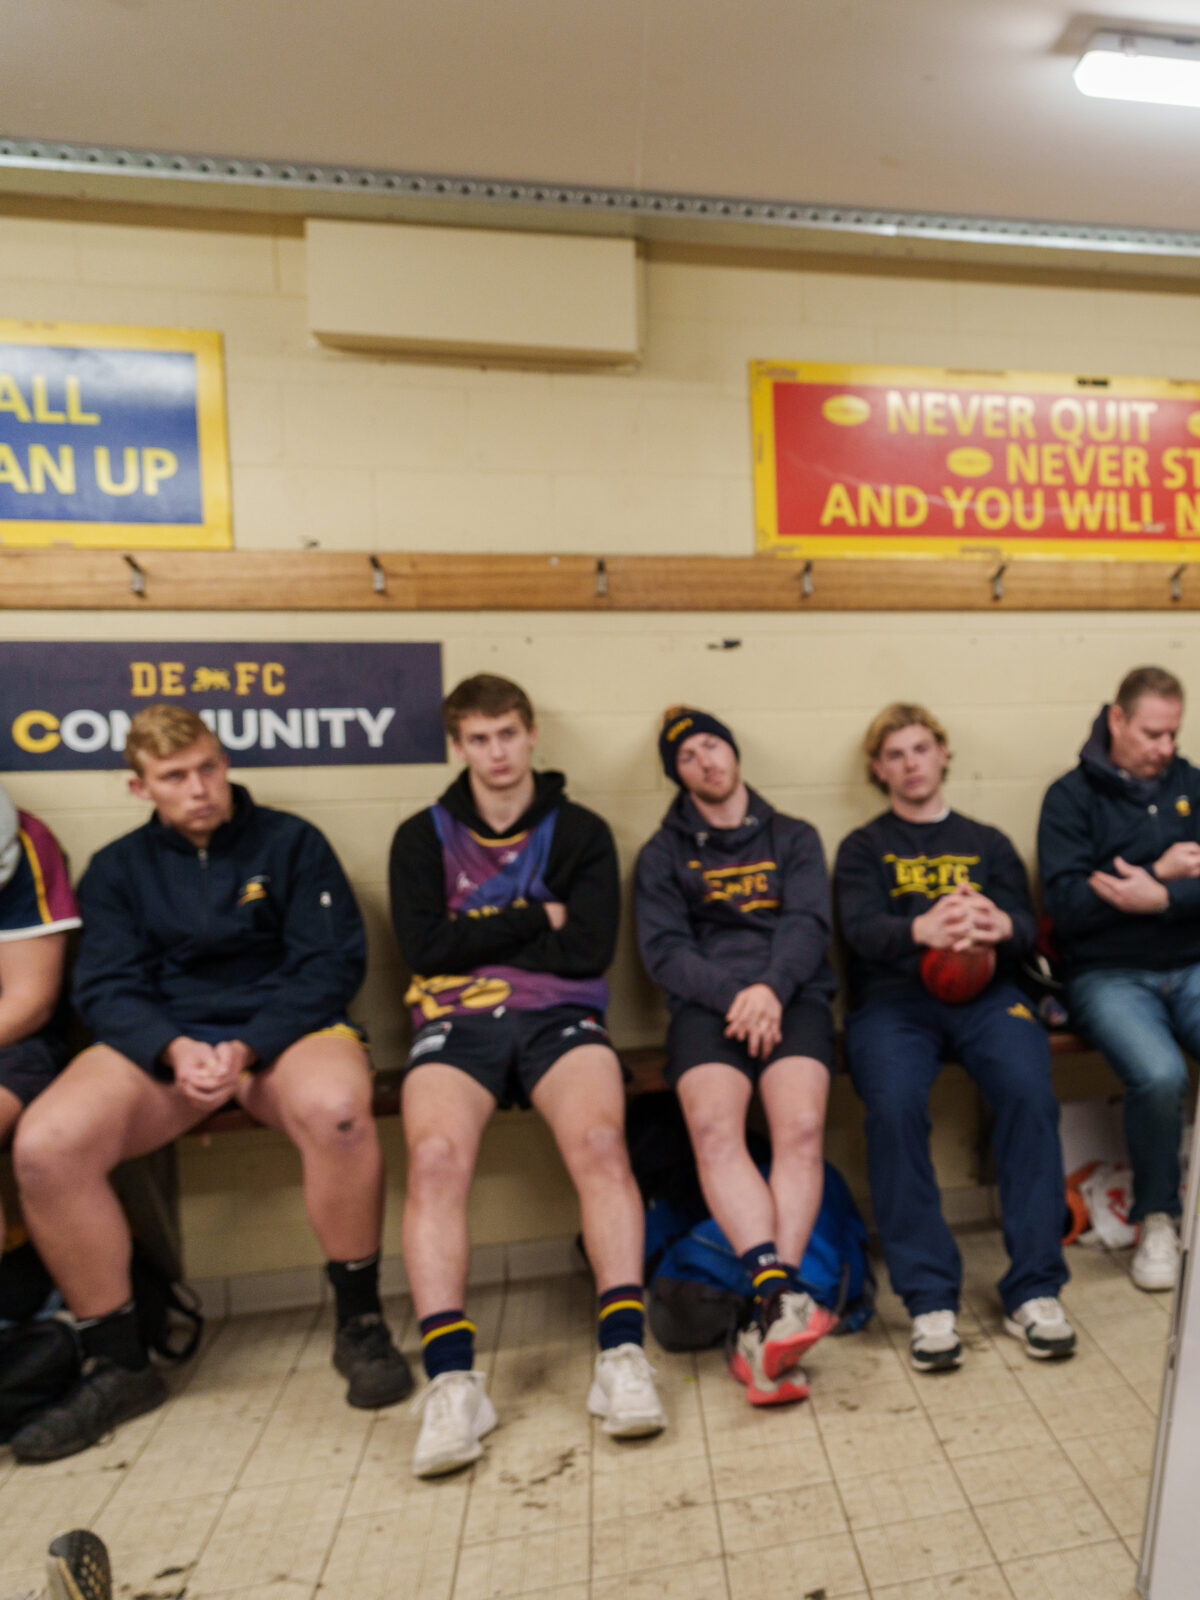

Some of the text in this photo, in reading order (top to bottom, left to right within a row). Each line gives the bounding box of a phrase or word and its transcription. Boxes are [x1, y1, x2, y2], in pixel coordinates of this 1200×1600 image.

[0, 373, 100, 425] ALL
[886, 390, 1159, 446] NEVER QUIT
[94, 445, 179, 496] UP
[1006, 442, 1151, 488] NEVER
[820, 483, 929, 528] AND
[941, 486, 1045, 531] YOU
[1057, 489, 1163, 533] WILL
[131, 662, 286, 697] DE FC
[12, 707, 395, 753] COUNITY
